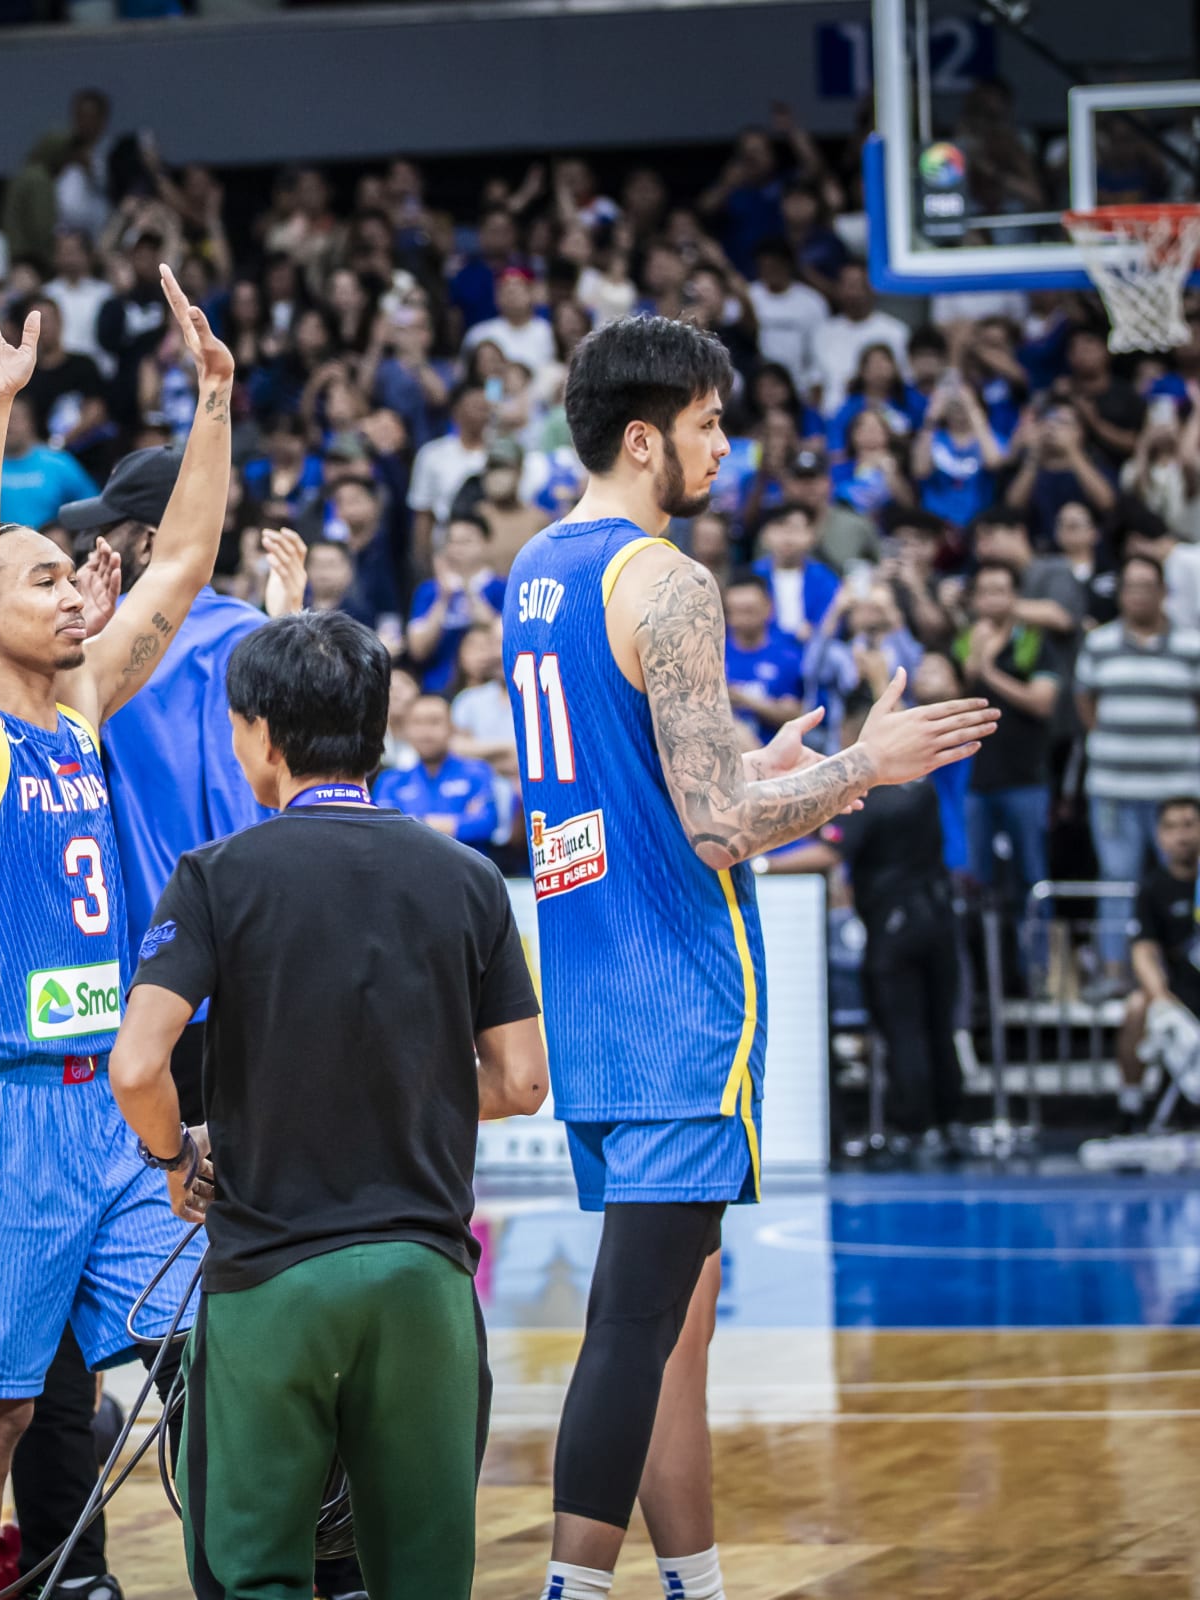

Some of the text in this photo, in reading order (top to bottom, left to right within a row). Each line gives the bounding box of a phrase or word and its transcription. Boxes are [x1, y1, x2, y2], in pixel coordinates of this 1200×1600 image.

[839, 17, 976, 94] 12
[519, 577, 565, 624] SOTTO
[512, 651, 576, 783] 11
[64, 835, 110, 936] 3
[75, 981, 119, 1017] Sma
